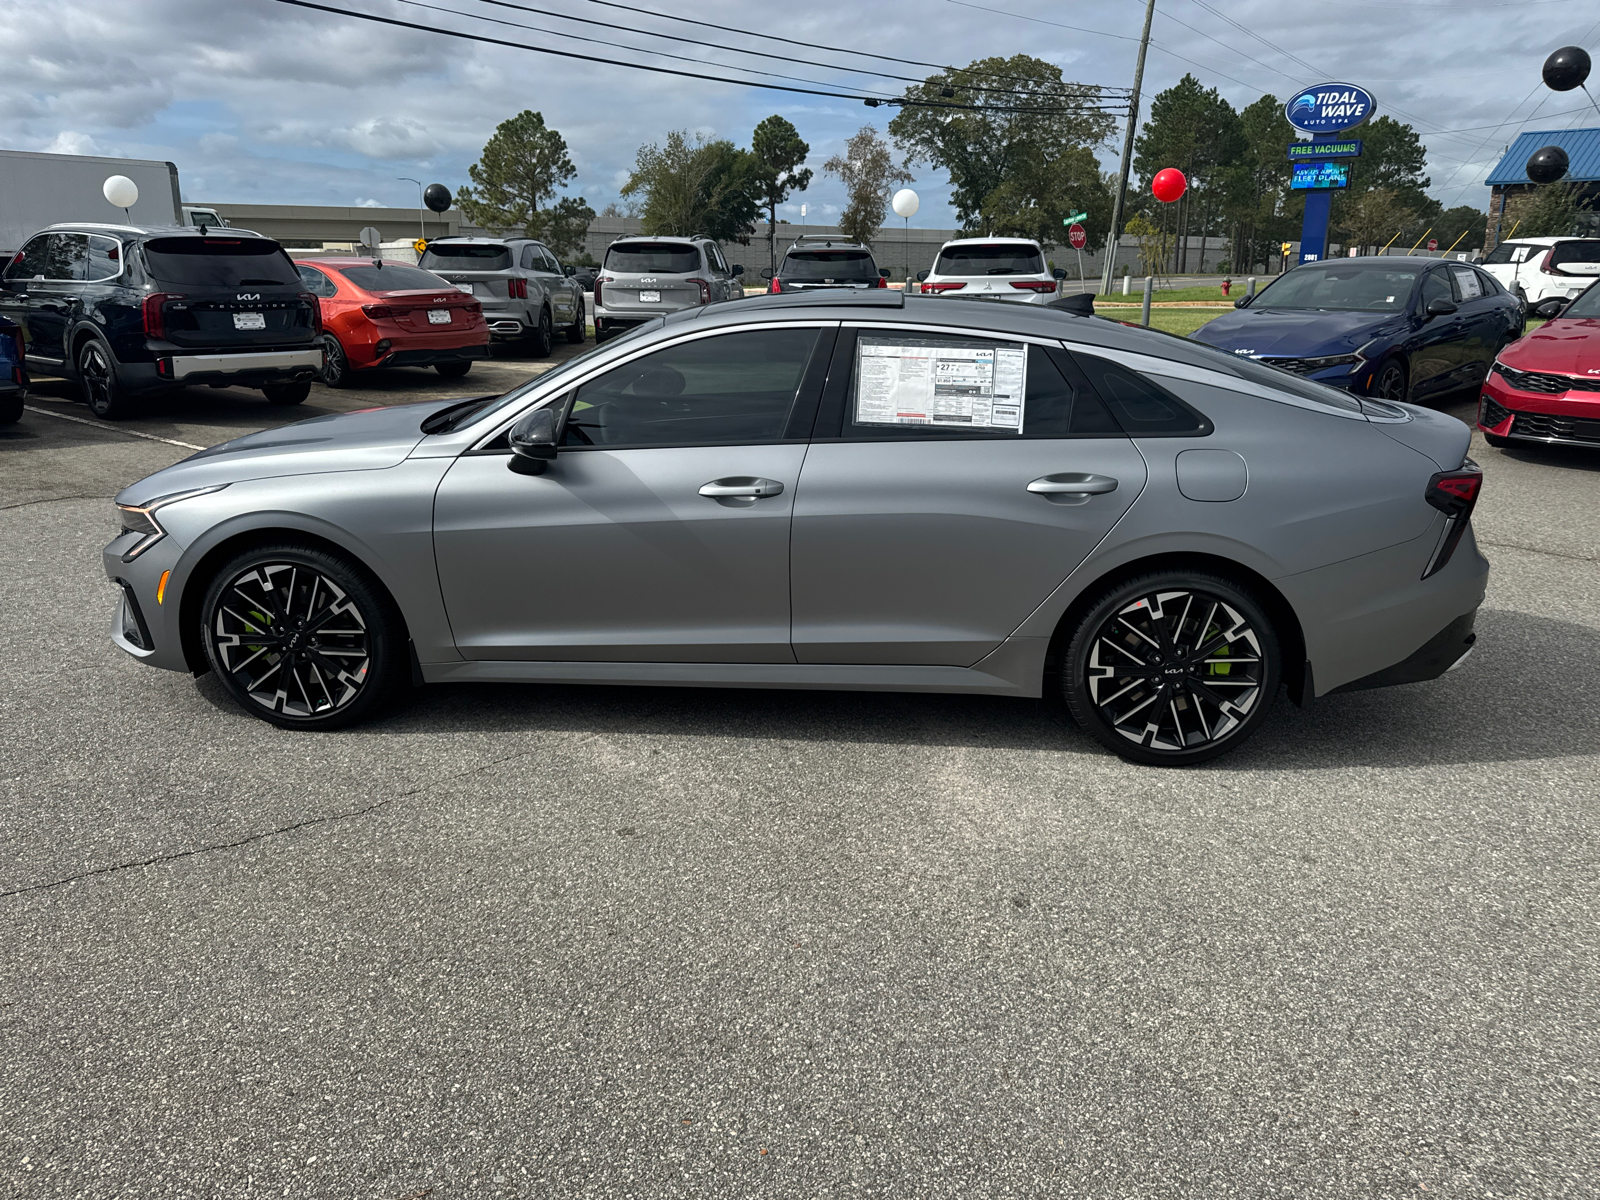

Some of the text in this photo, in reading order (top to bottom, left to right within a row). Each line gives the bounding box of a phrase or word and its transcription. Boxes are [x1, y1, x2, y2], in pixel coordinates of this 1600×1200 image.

[1316, 91, 1357, 105] TIDAL
[1321, 104, 1365, 117] WAVE
[1290, 143, 1356, 155] FREE VACUUMS
[1070, 231, 1085, 241] STOP
[236, 293, 260, 301] KIA
[940, 363, 950, 371] 27
